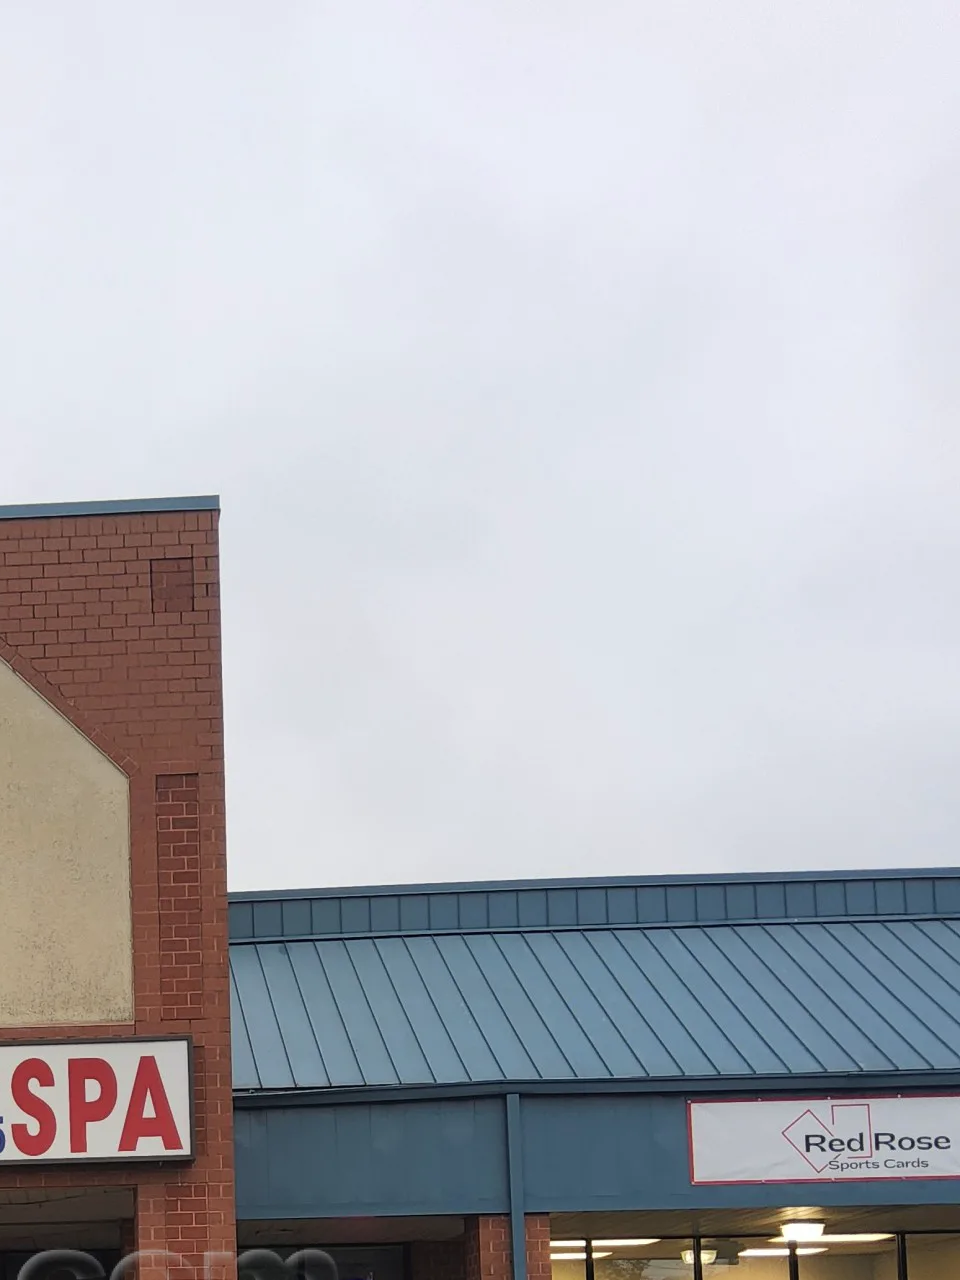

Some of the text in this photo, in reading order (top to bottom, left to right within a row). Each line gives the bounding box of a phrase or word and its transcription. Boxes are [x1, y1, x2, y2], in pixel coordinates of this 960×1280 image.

[10, 1055, 184, 1157] SPA
[804, 1132, 951, 1153] Red Rose
[828, 1157, 929, 1172] Sports Cards
